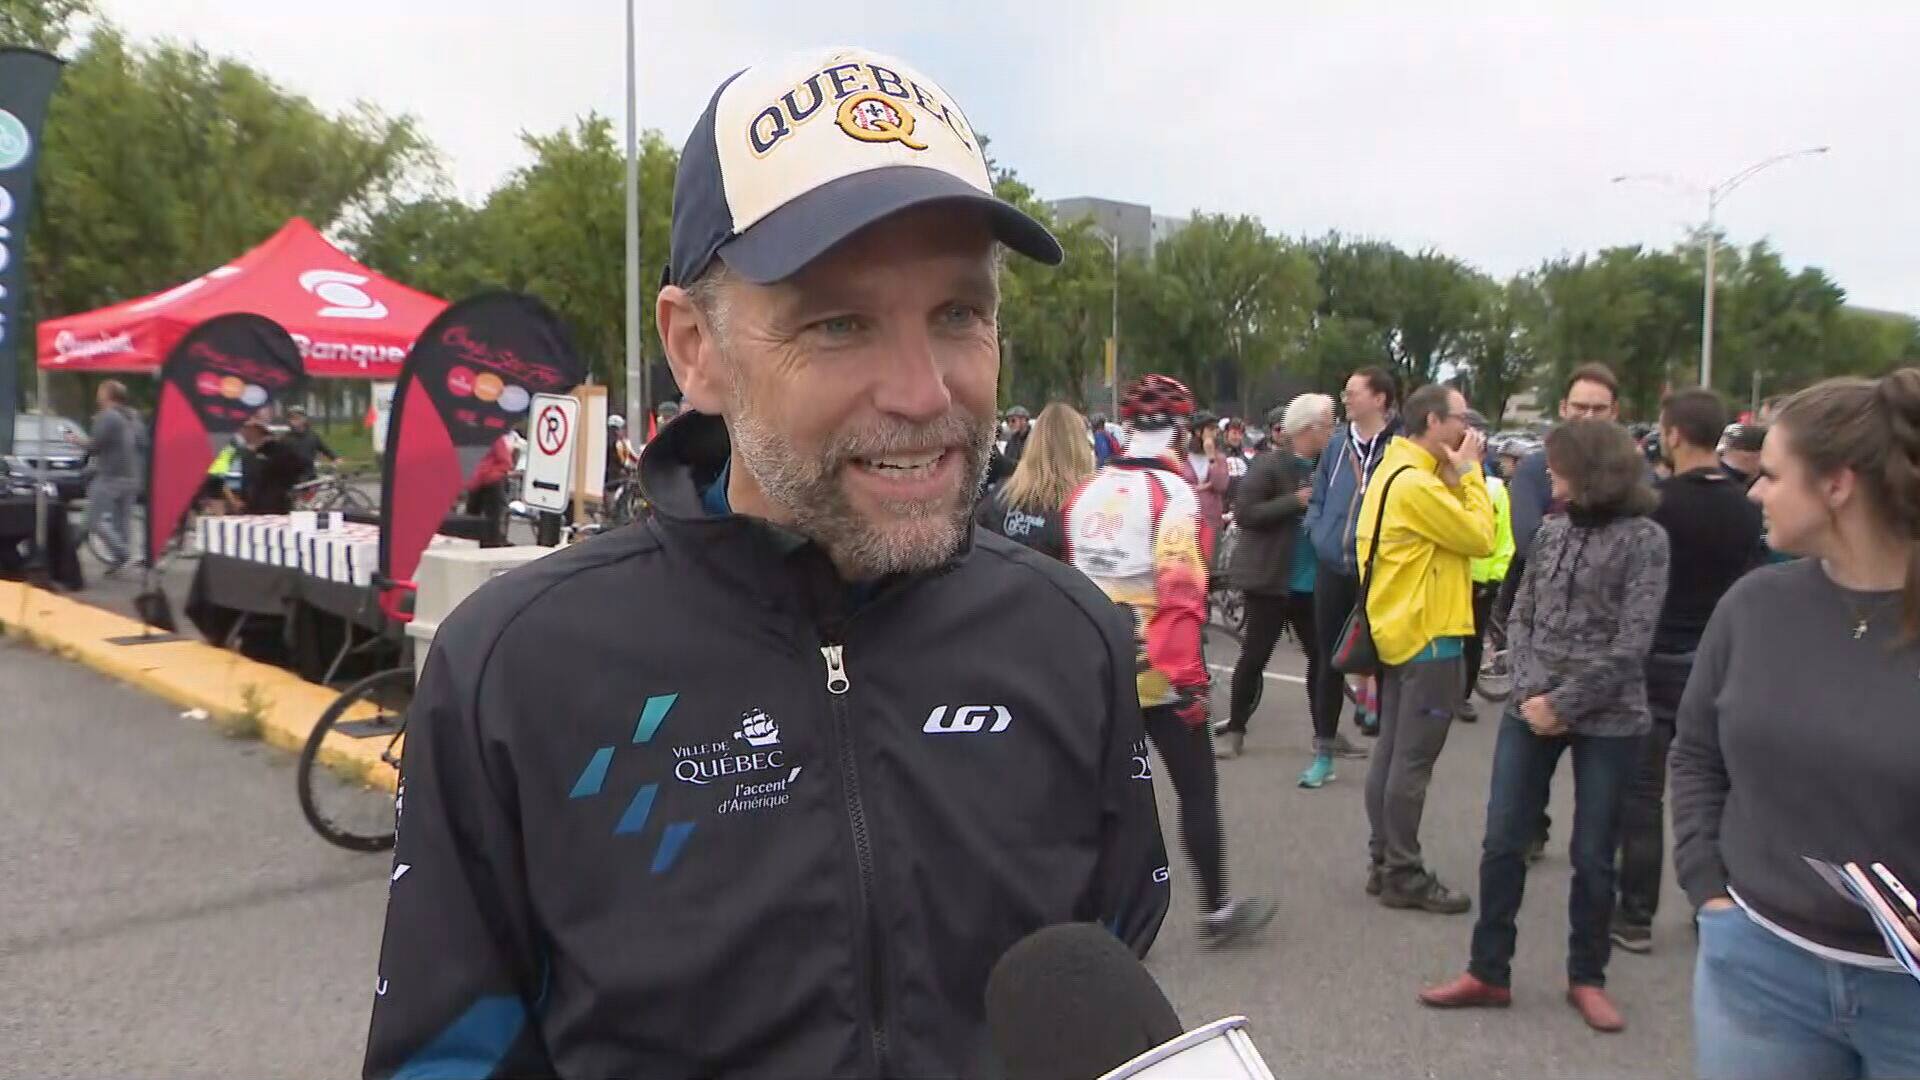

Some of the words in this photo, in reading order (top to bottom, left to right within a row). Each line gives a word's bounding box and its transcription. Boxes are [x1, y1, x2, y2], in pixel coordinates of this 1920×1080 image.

[672, 743, 711, 759] VILLE
[712, 741, 730, 753] DE
[675, 750, 785, 784] QUÉBEC
[735, 778, 787, 797] l'accent
[717, 794, 790, 814] d'Amérique
